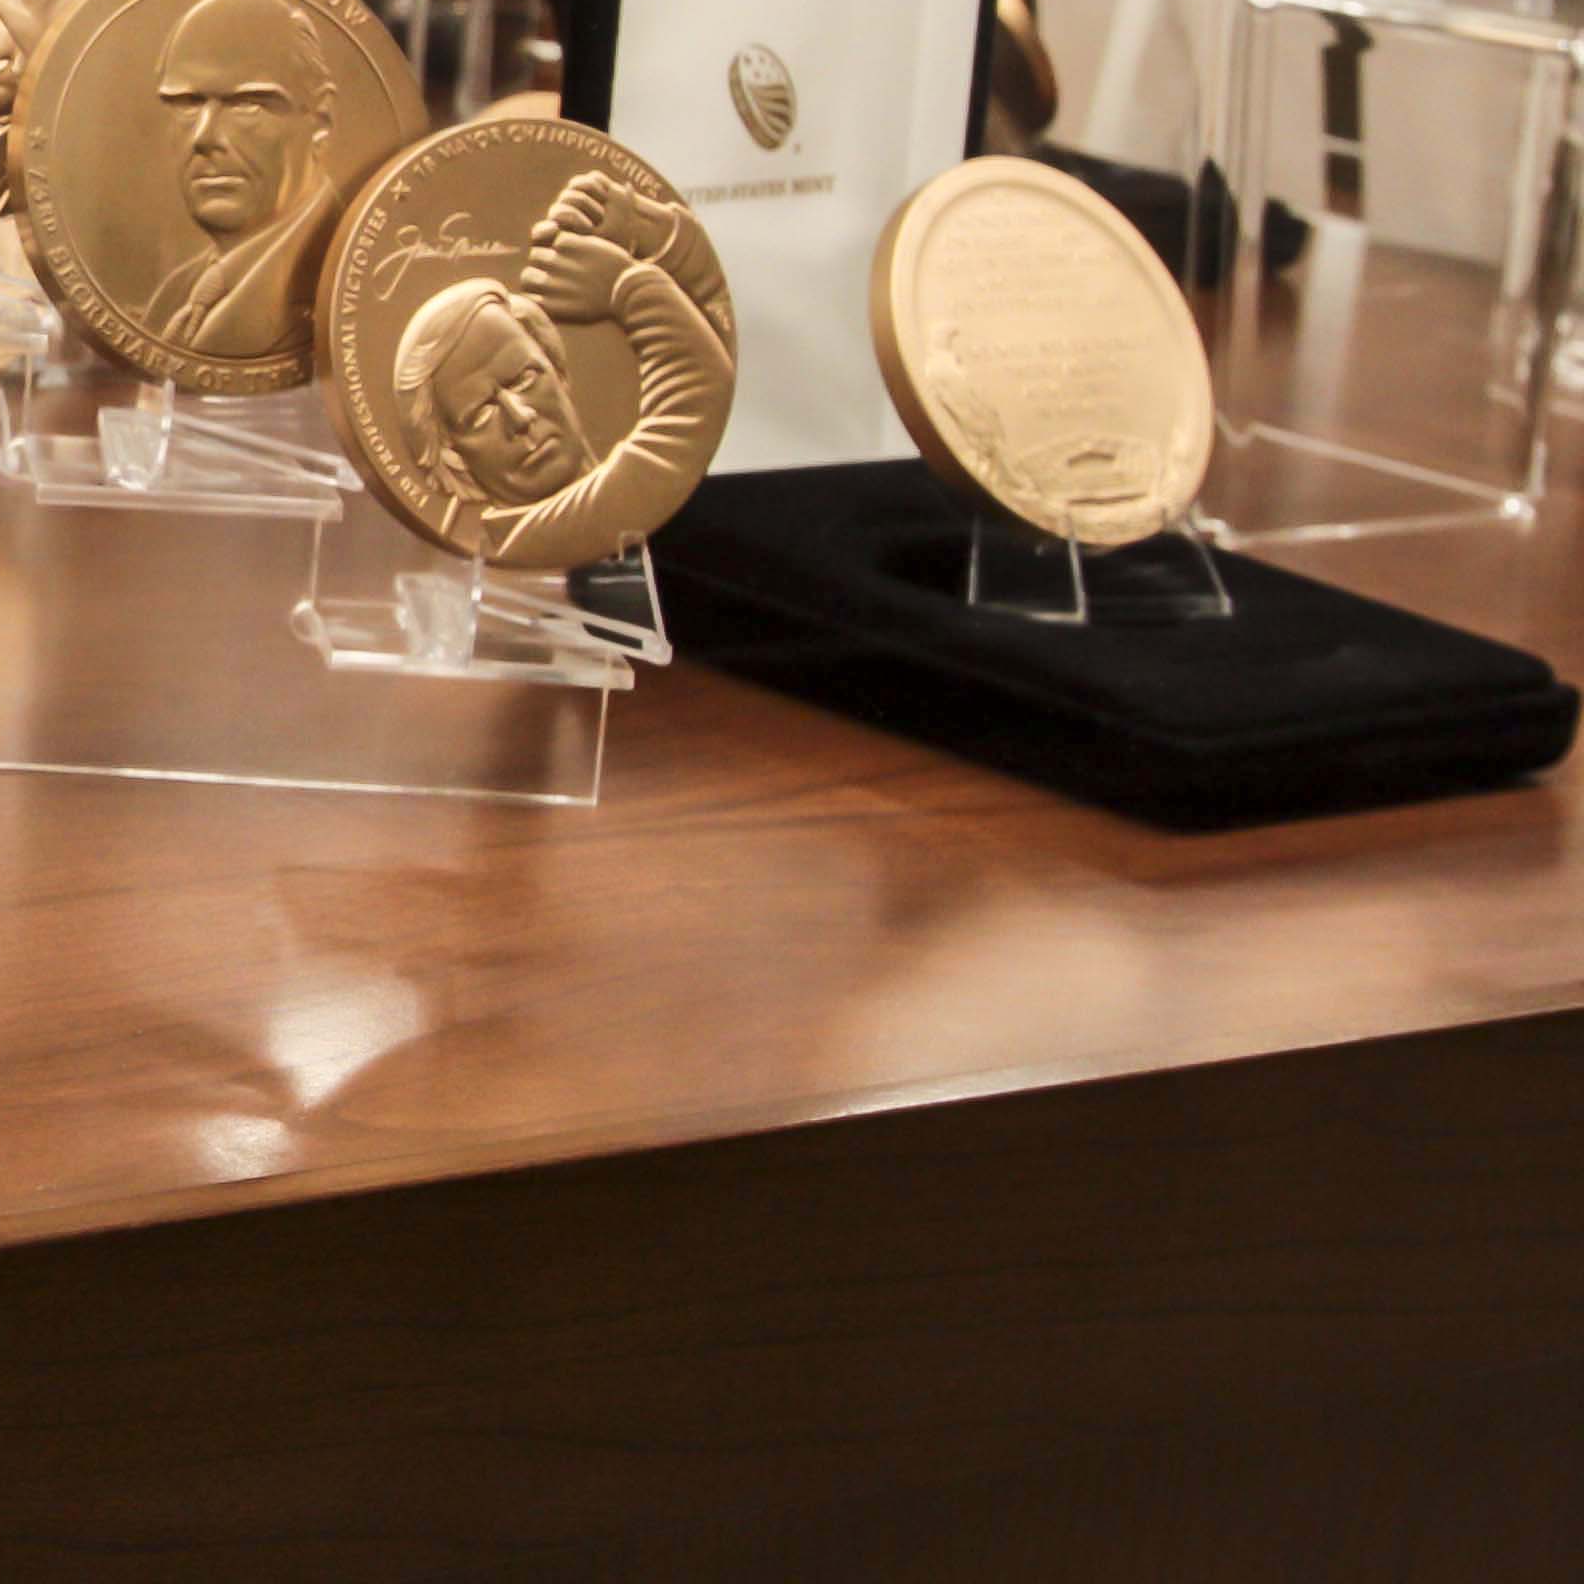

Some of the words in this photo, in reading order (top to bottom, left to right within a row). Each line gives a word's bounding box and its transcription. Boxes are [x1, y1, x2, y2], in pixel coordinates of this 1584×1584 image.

[436, 126, 503, 159] MAJOR
[506, 122, 664, 200] CHAMPIONSHIPS
[47, 245, 185, 375] SECRETARY
[341, 206, 388, 314] VICTORIES
[340, 323, 402, 476] PROFESSIONAL
